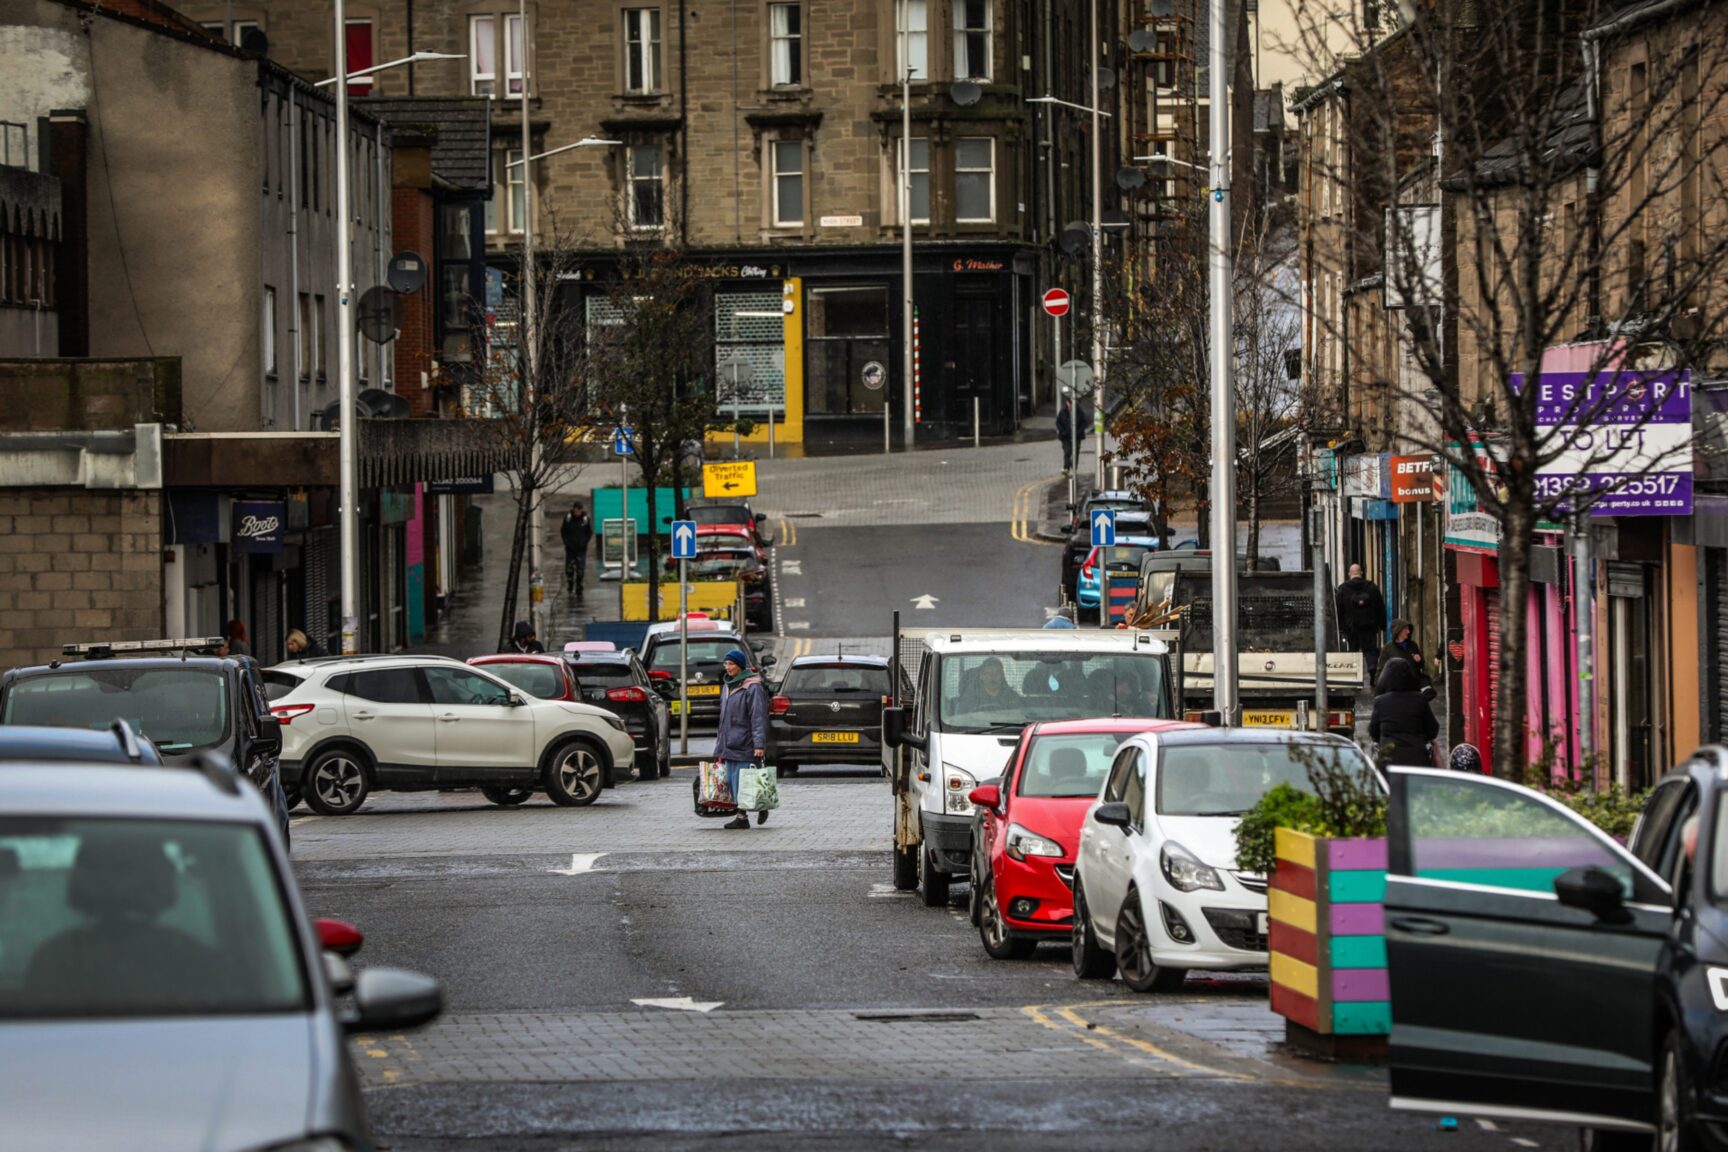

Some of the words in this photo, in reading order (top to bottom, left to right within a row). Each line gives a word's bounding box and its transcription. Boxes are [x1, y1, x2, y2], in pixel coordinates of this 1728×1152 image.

[1560, 430, 1594, 451] TO
[1606, 429, 1646, 450] LET
[709, 464, 748, 473] Diverted
[714, 472, 745, 480] Traffic
[1600, 474, 1680, 496] 225517
[1398, 487, 1431, 496] bonus
[237, 515, 279, 537] Boots
[1248, 714, 1268, 724] YN13
[1268, 714, 1285, 724] CFV
